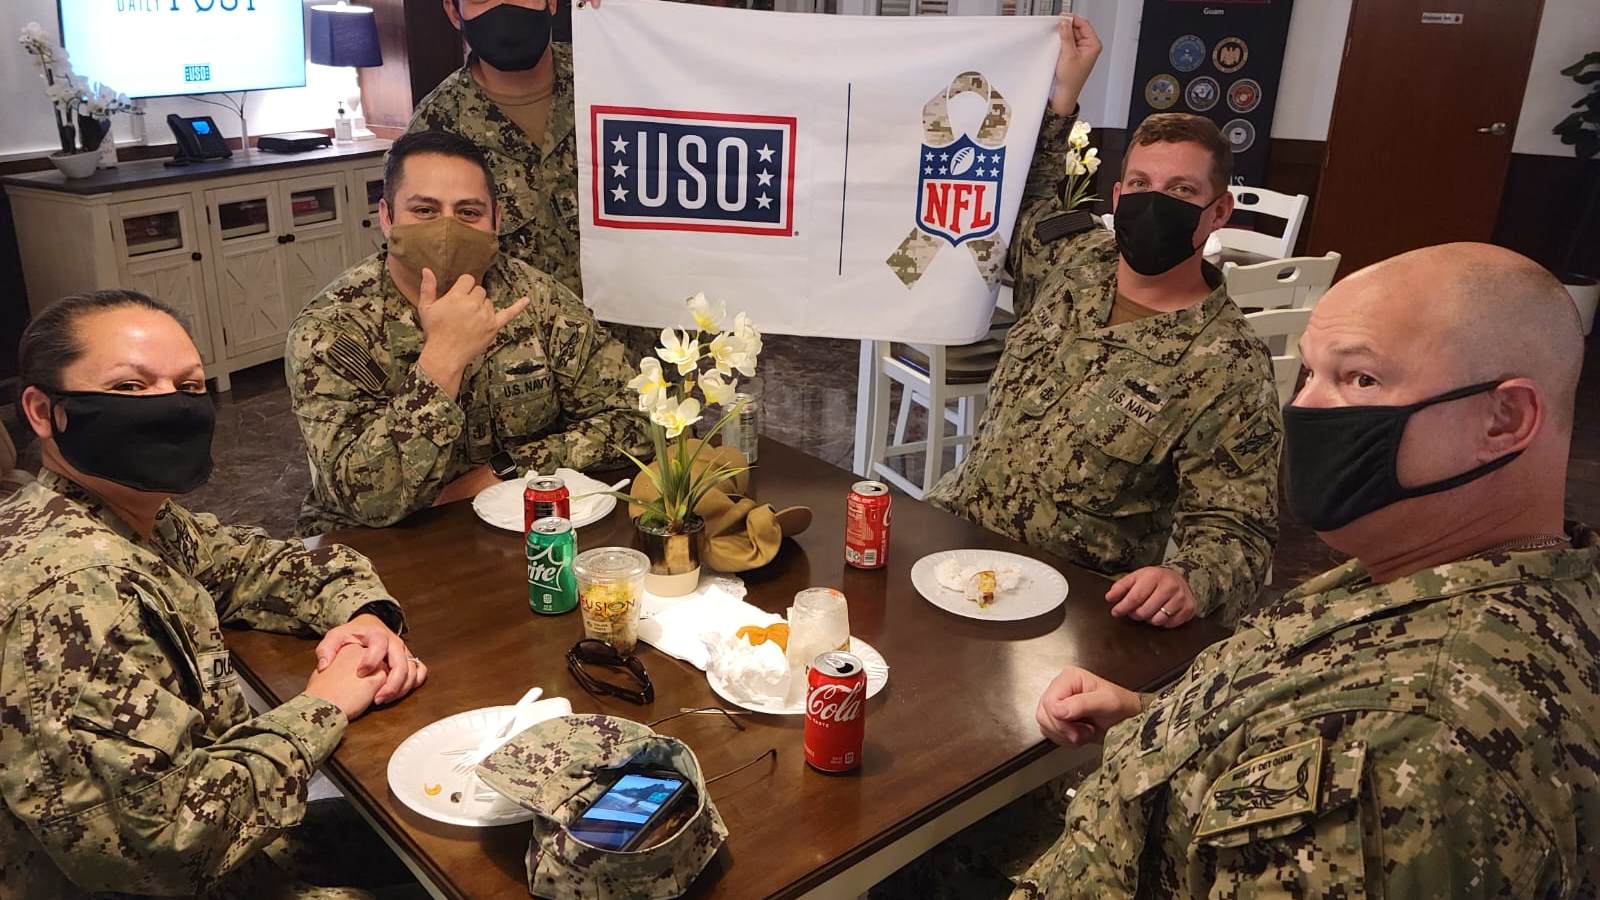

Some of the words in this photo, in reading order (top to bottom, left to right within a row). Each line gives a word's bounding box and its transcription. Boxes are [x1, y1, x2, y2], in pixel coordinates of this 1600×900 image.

[1203, 7, 1225, 16] Guam
[190, 66, 206, 80] USO
[637, 131, 748, 212] USO
[924, 182, 991, 234] NFL
[503, 384, 523, 398] U.S.
[524, 377, 551, 393] NAVY
[1108, 388, 1125, 406] U.S.
[1125, 399, 1156, 423] NAVY
[808, 682, 862, 722] Cola
